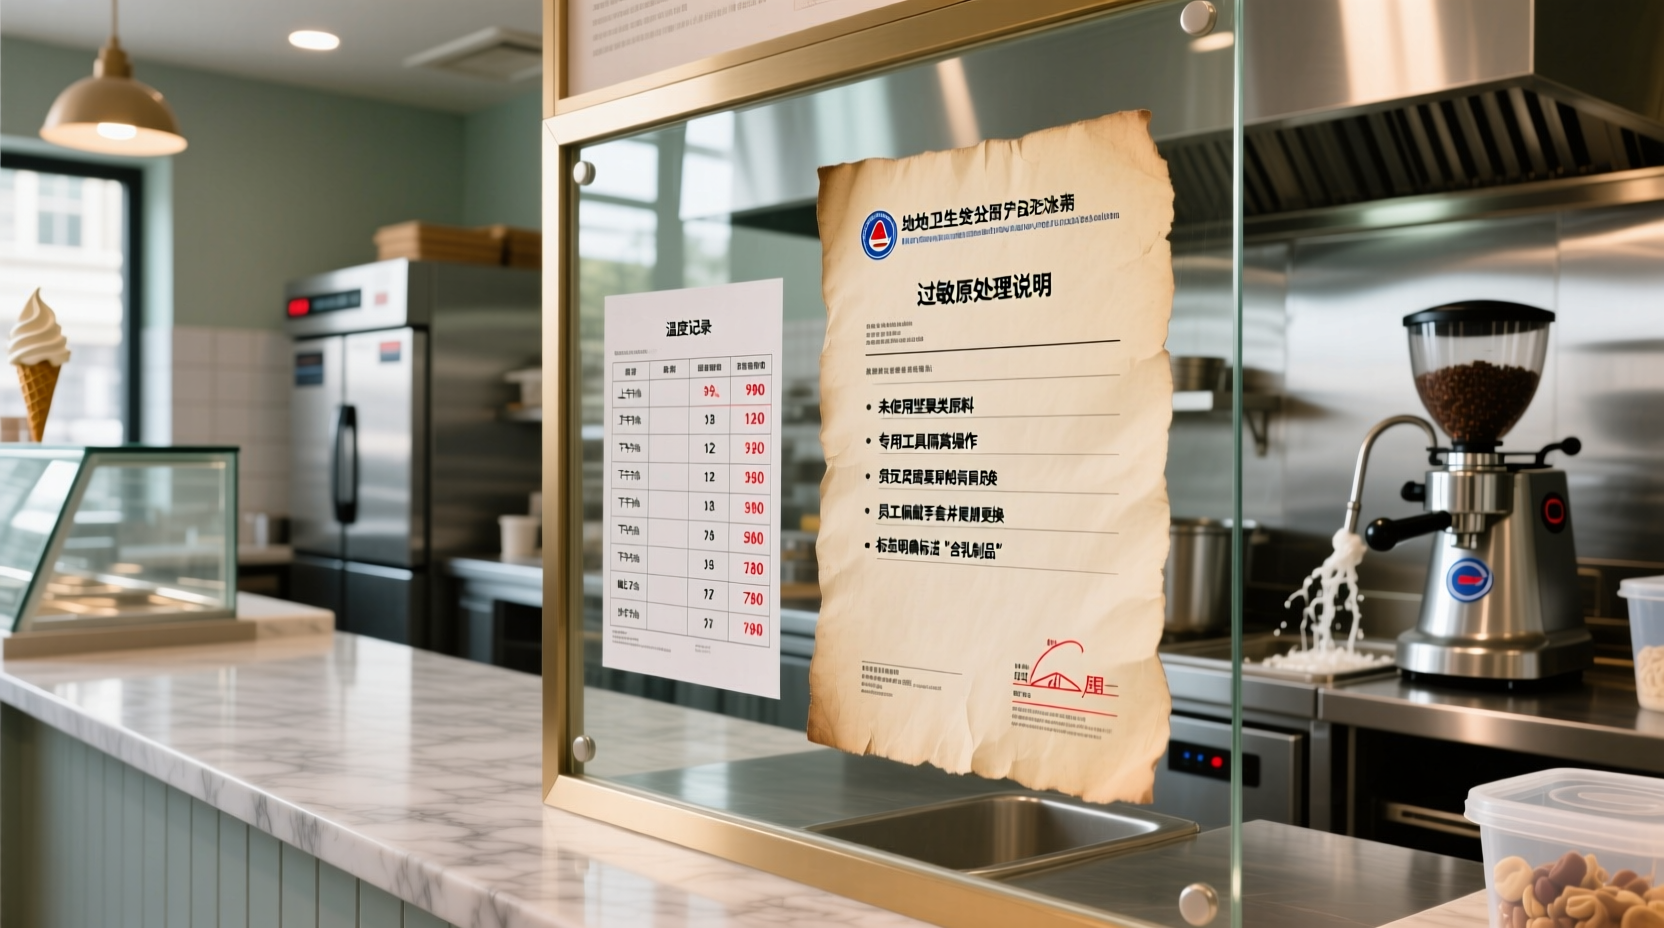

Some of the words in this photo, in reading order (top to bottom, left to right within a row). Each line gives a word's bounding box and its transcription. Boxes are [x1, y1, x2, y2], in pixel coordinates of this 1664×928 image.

[917, 272, 1051, 306] 过敏原处理说明
[666, 320, 712, 336] 温度记录
[704, 442, 716, 454] 12
[704, 471, 716, 483] 12
